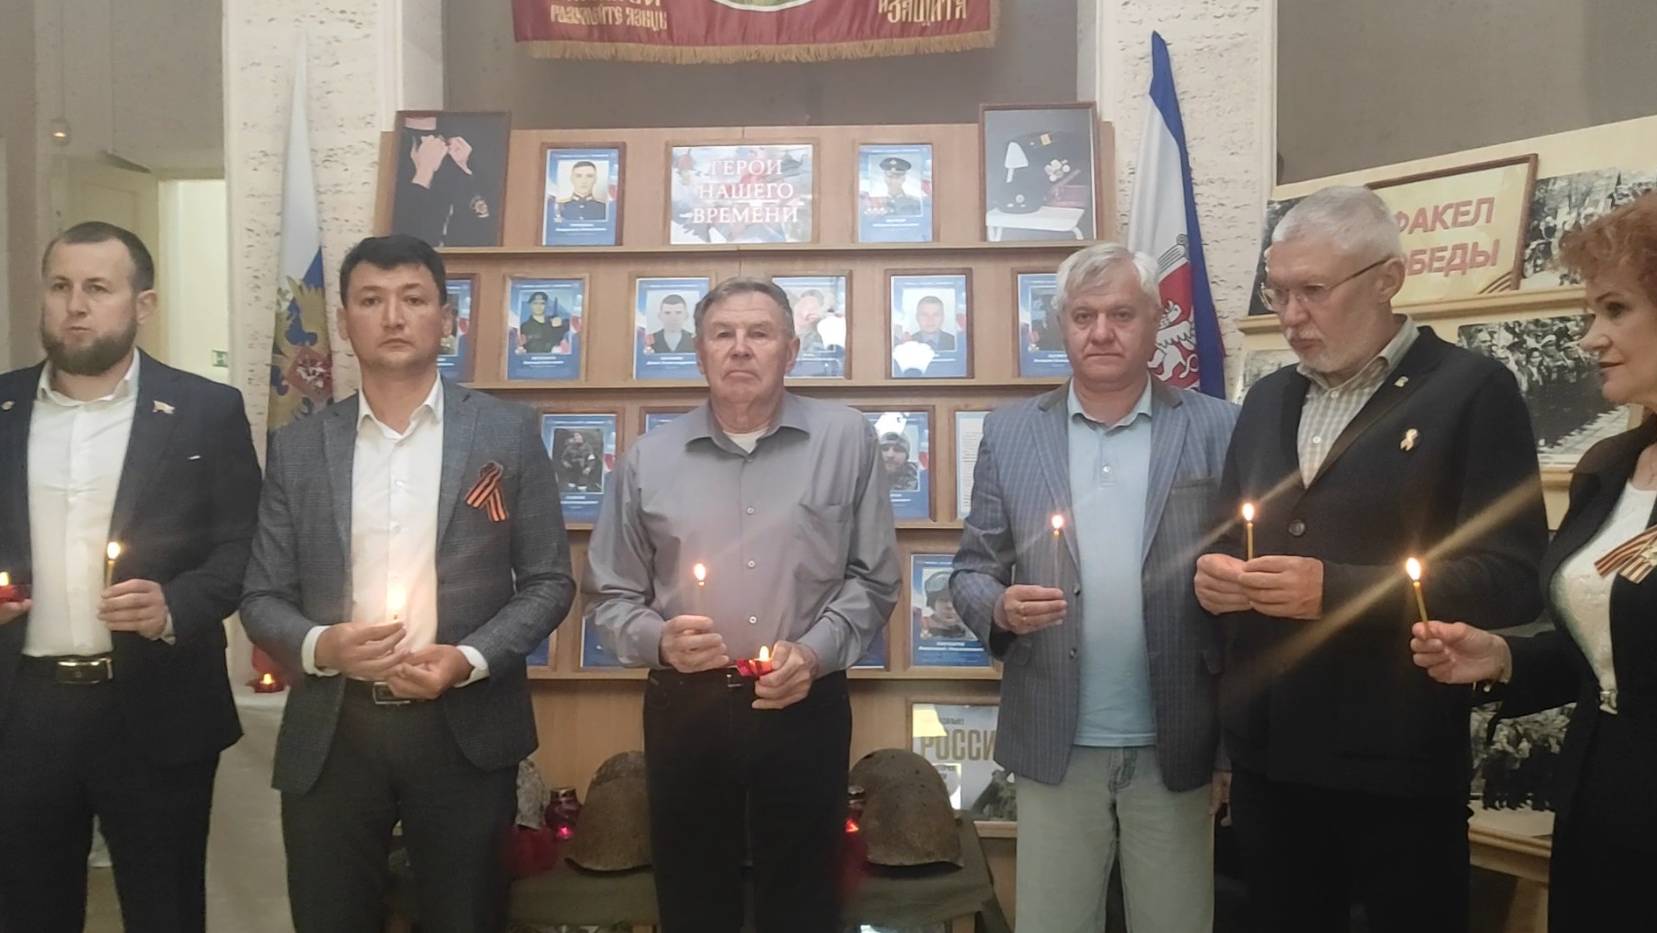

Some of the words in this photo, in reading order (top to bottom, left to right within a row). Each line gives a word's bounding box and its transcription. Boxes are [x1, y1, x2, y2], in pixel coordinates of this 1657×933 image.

[711, 160, 782, 175] ГЕРОИ
[699, 183, 794, 199] НАШЕГО
[692, 206, 800, 223] ВРЕМЕНИ
[1404, 238, 1500, 278] БЕДЫ
